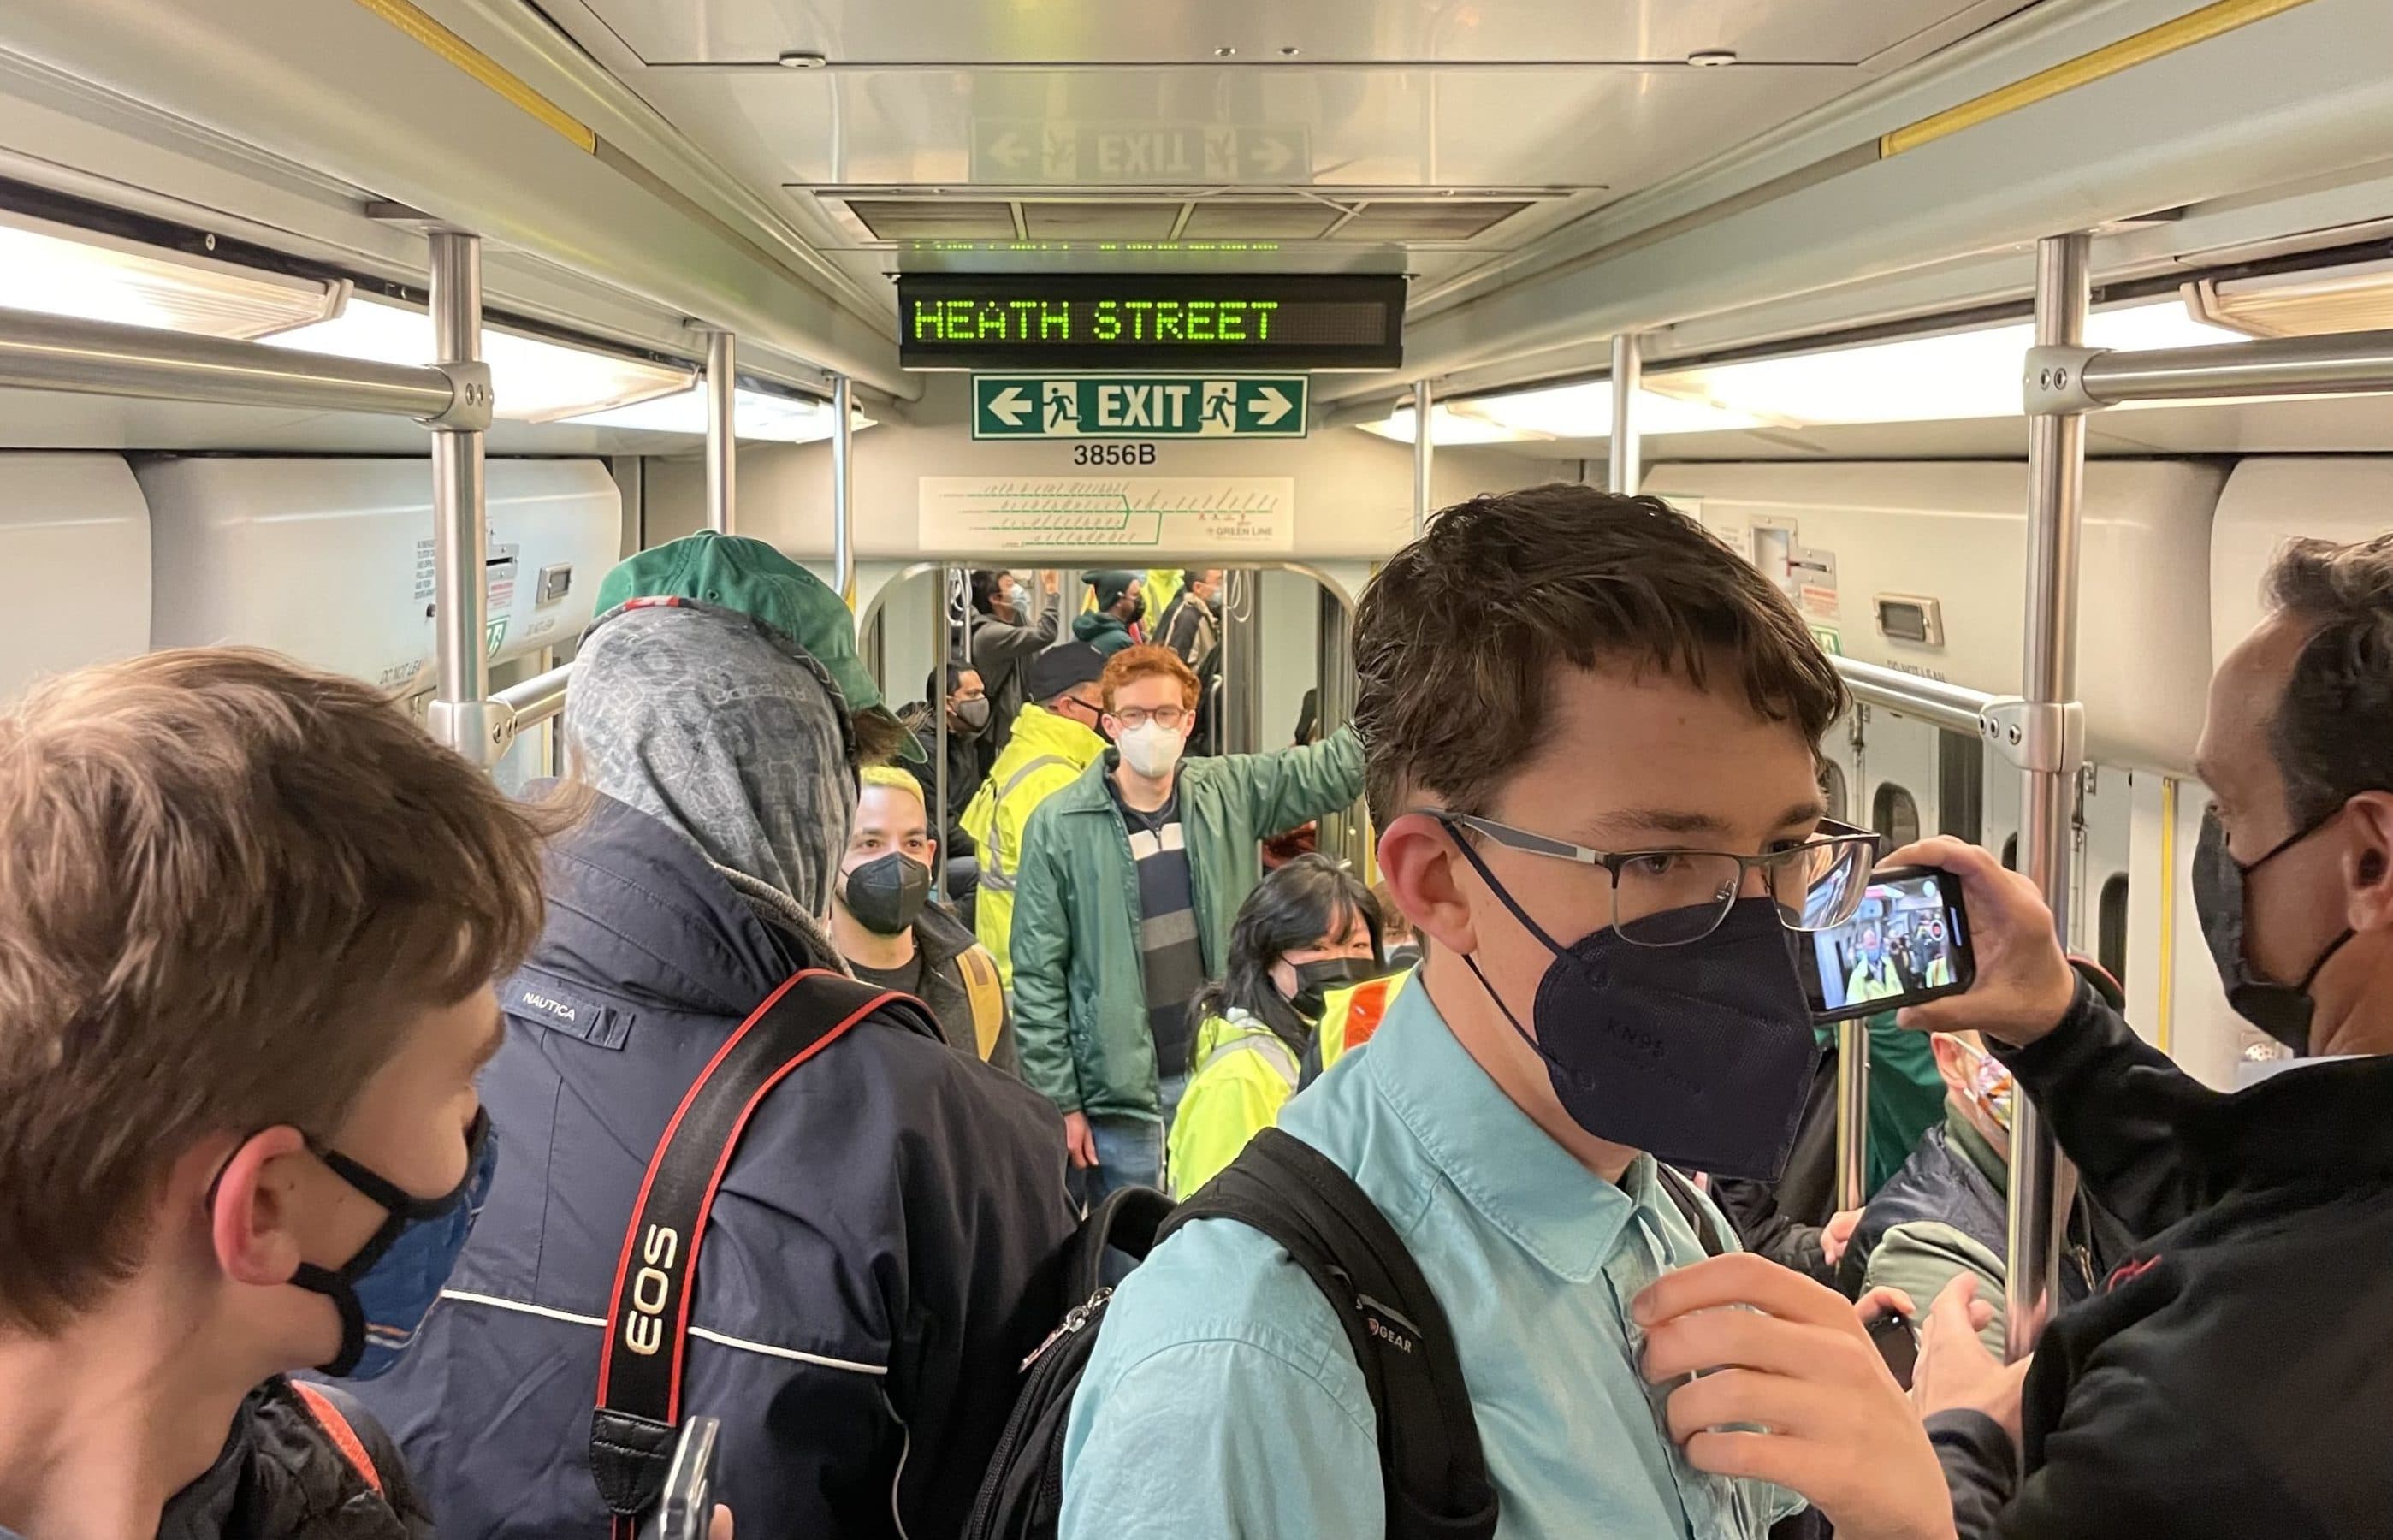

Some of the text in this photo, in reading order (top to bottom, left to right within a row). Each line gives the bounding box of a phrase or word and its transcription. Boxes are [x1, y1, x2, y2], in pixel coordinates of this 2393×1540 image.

[915, 301, 1278, 340] HEATH STREET
[1098, 385, 1191, 427] EXIT
[1074, 443, 1156, 465] 3856B
[1217, 526, 1273, 536] GREEN LINE
[523, 992, 576, 1022] NAUTICA
[625, 1223, 678, 1355] EOS
